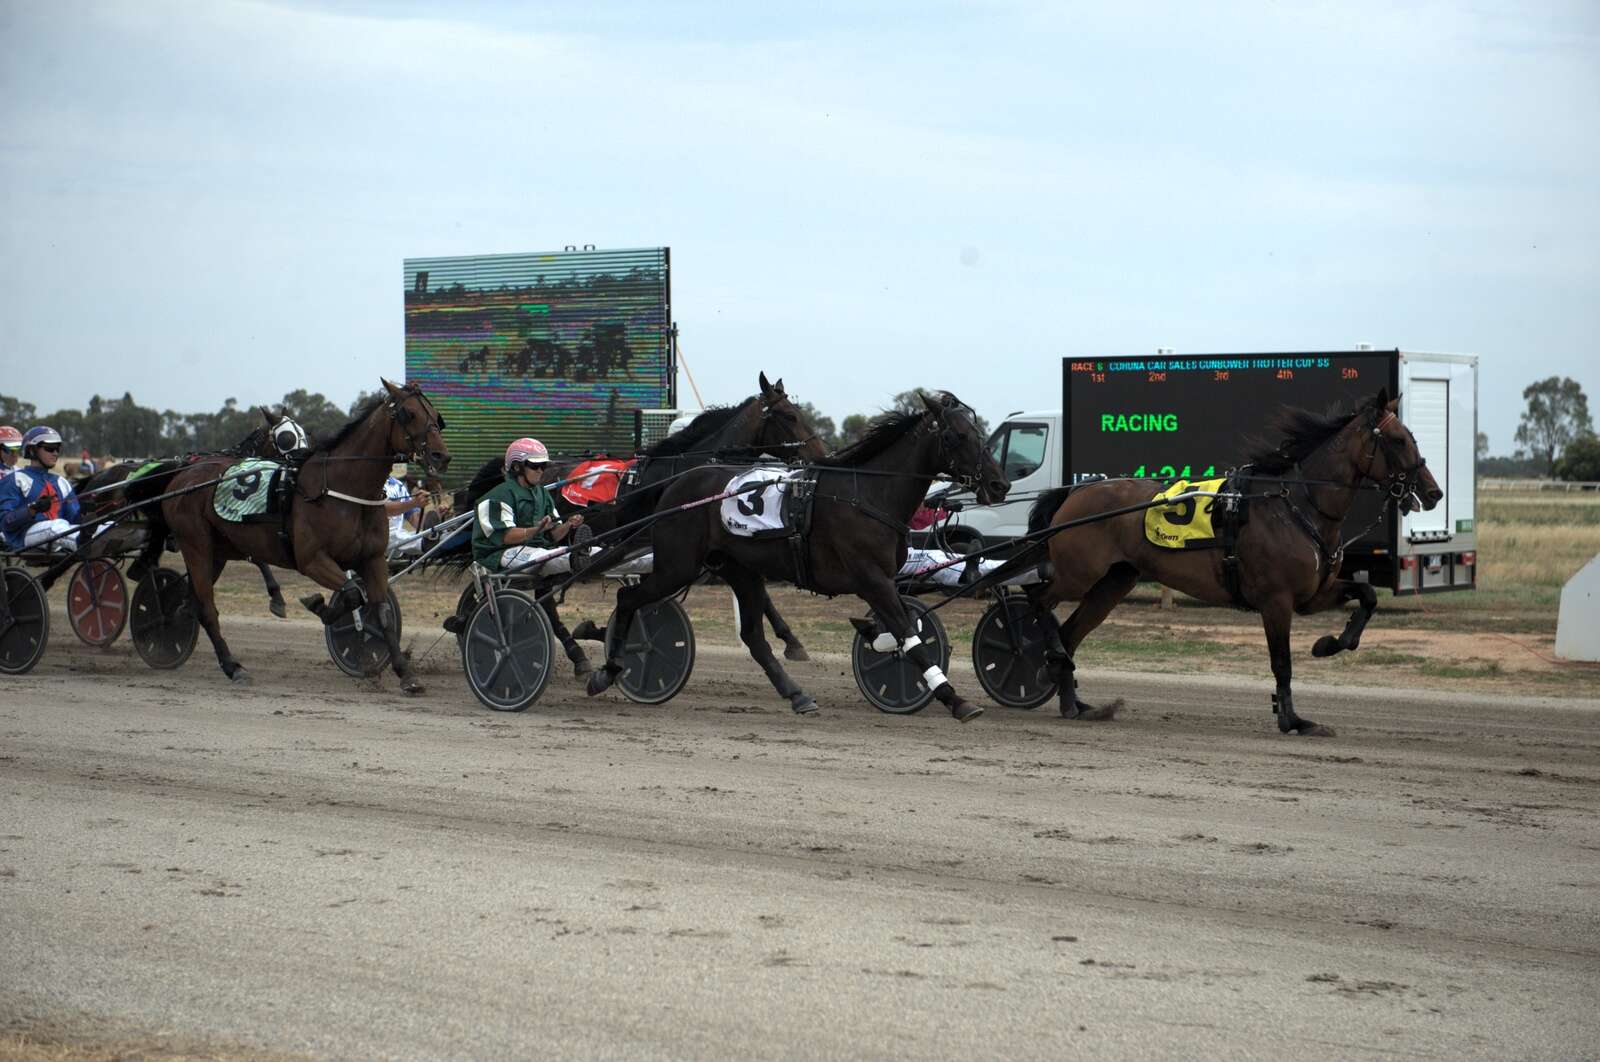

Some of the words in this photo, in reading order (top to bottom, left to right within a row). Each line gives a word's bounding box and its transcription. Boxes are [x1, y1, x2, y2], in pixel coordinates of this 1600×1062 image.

[1071, 362, 1095, 371] RACE
[1295, 358, 1315, 368] CUP
[1148, 371, 1167, 382] 2nd
[1214, 370, 1230, 381] 3rd
[1276, 369, 1294, 379] 4th
[1341, 368, 1359, 379] 5th
[1101, 414, 1178, 432] RACING
[232, 469, 262, 501] 9
[736, 481, 772, 516] 3
[1162, 486, 1200, 525] 5
